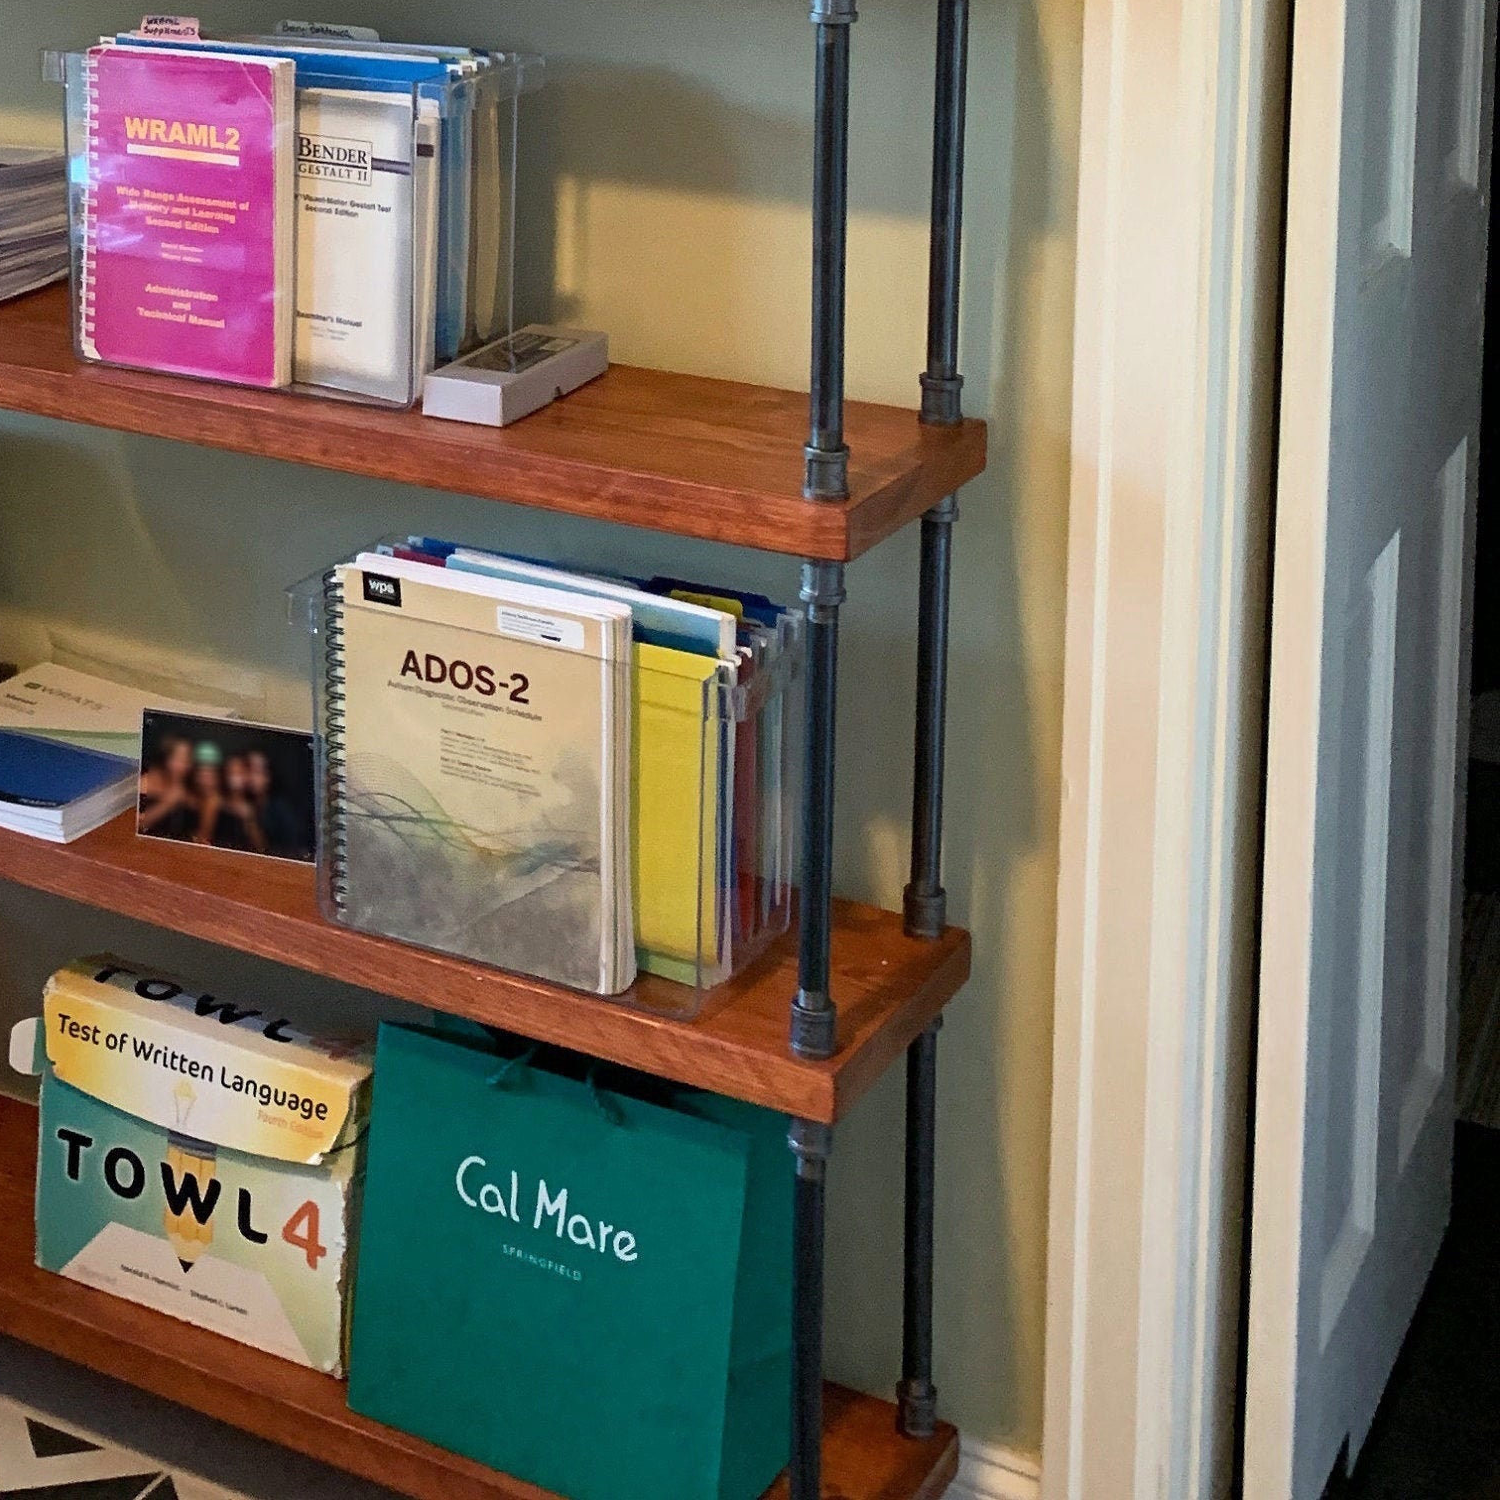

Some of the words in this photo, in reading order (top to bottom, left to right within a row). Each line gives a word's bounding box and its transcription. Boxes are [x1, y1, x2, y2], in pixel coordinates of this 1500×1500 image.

[124, 116, 241, 152] WRAML2
[298, 136, 368, 165] BENDER
[298, 163, 354, 180] GESTALT
[357, 171, 368, 181] II
[116, 185, 141, 198] Wide
[143, 188, 175, 202] Range
[176, 192, 237, 210] Assessment
[238, 201, 250, 212] of
[349, 199, 376, 210] Gestalt
[128, 200, 170, 215] Memory
[170, 206, 190, 216] and
[192, 207, 236, 225] Learning
[305, 203, 333, 214] Second
[334, 208, 359, 218] Edition
[145, 216, 182, 230] Second
[184, 220, 220, 234] Edition
[145, 283, 219, 302] Administration
[136, 306, 187, 323] Technical
[188, 314, 226, 329] Manual
[172, 301, 192, 311] and
[335, 316, 363, 328] Manual
[368, 579, 395, 595] wps
[400, 649, 530, 706] ADOS-2
[387, 680, 414, 692] Autism
[414, 685, 455, 702] Diagnostic
[456, 694, 504, 713] Observation
[505, 706, 543, 722] Schedule
[57, 1012, 101, 1046] Test
[105, 1032, 128, 1053] of
[132, 1035, 214, 1083] Written
[220, 1065, 329, 1122] Language
[257, 1109, 288, 1128] Fourth
[456, 1155, 520, 1223] Cal
[533, 1179, 638, 1262] Mare
[502, 1244, 583, 1281] SPRINGFIELD
